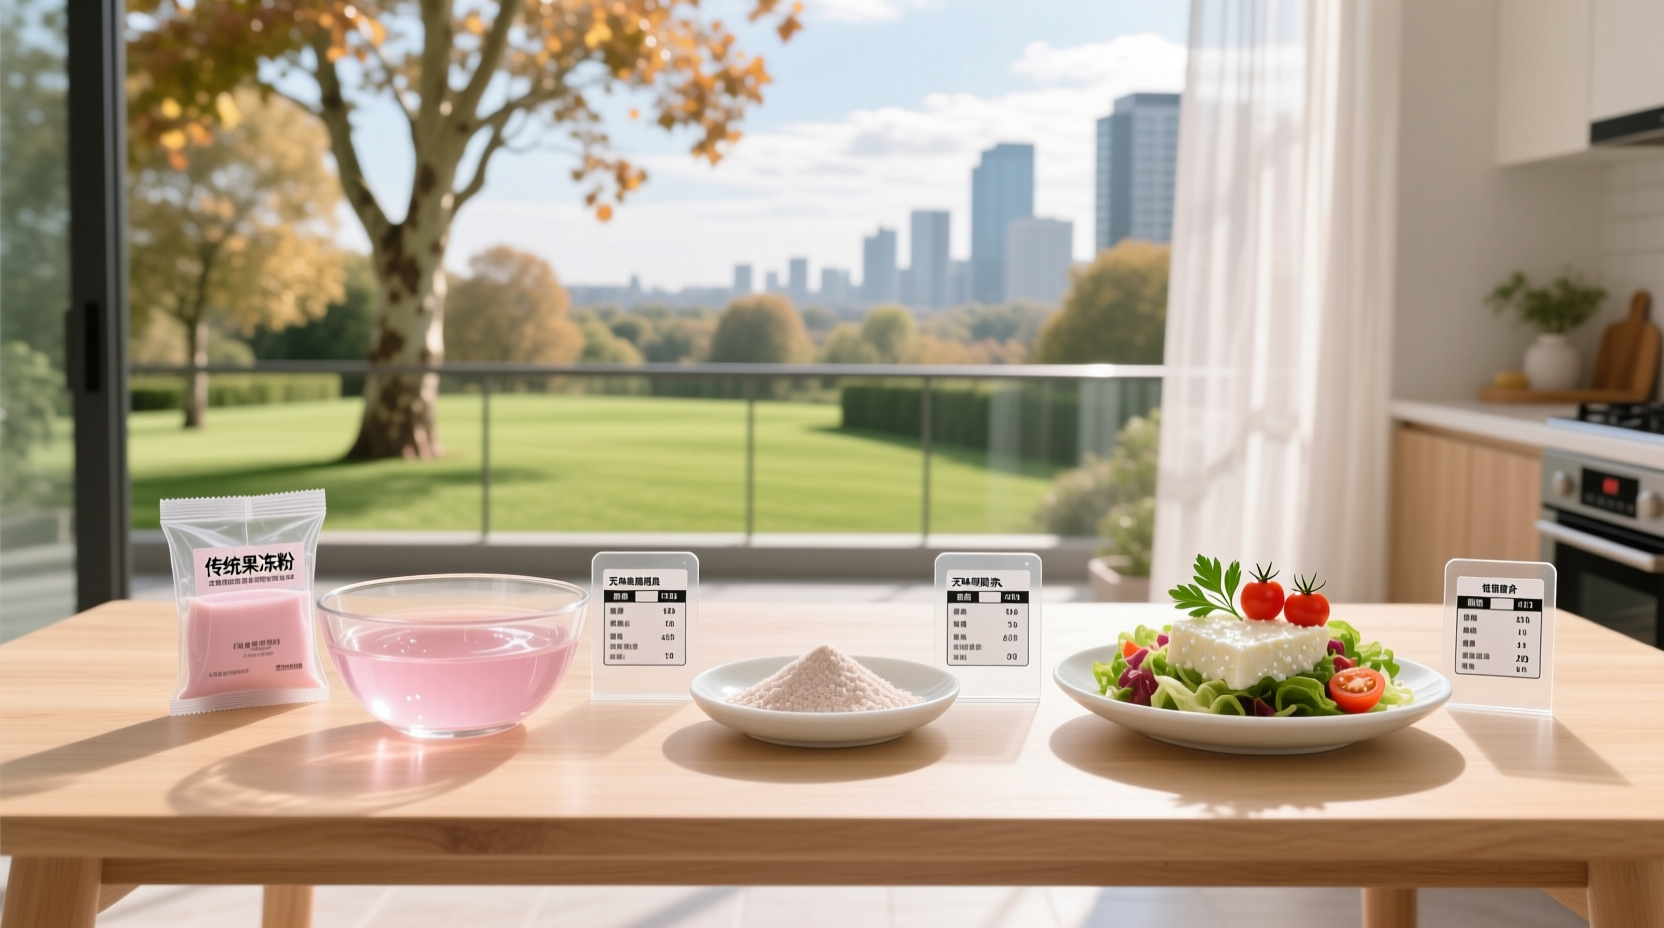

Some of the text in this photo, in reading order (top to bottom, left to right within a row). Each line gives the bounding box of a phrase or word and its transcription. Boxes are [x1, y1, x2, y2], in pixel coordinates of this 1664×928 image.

[205, 551, 295, 577] 传统果冻粉
